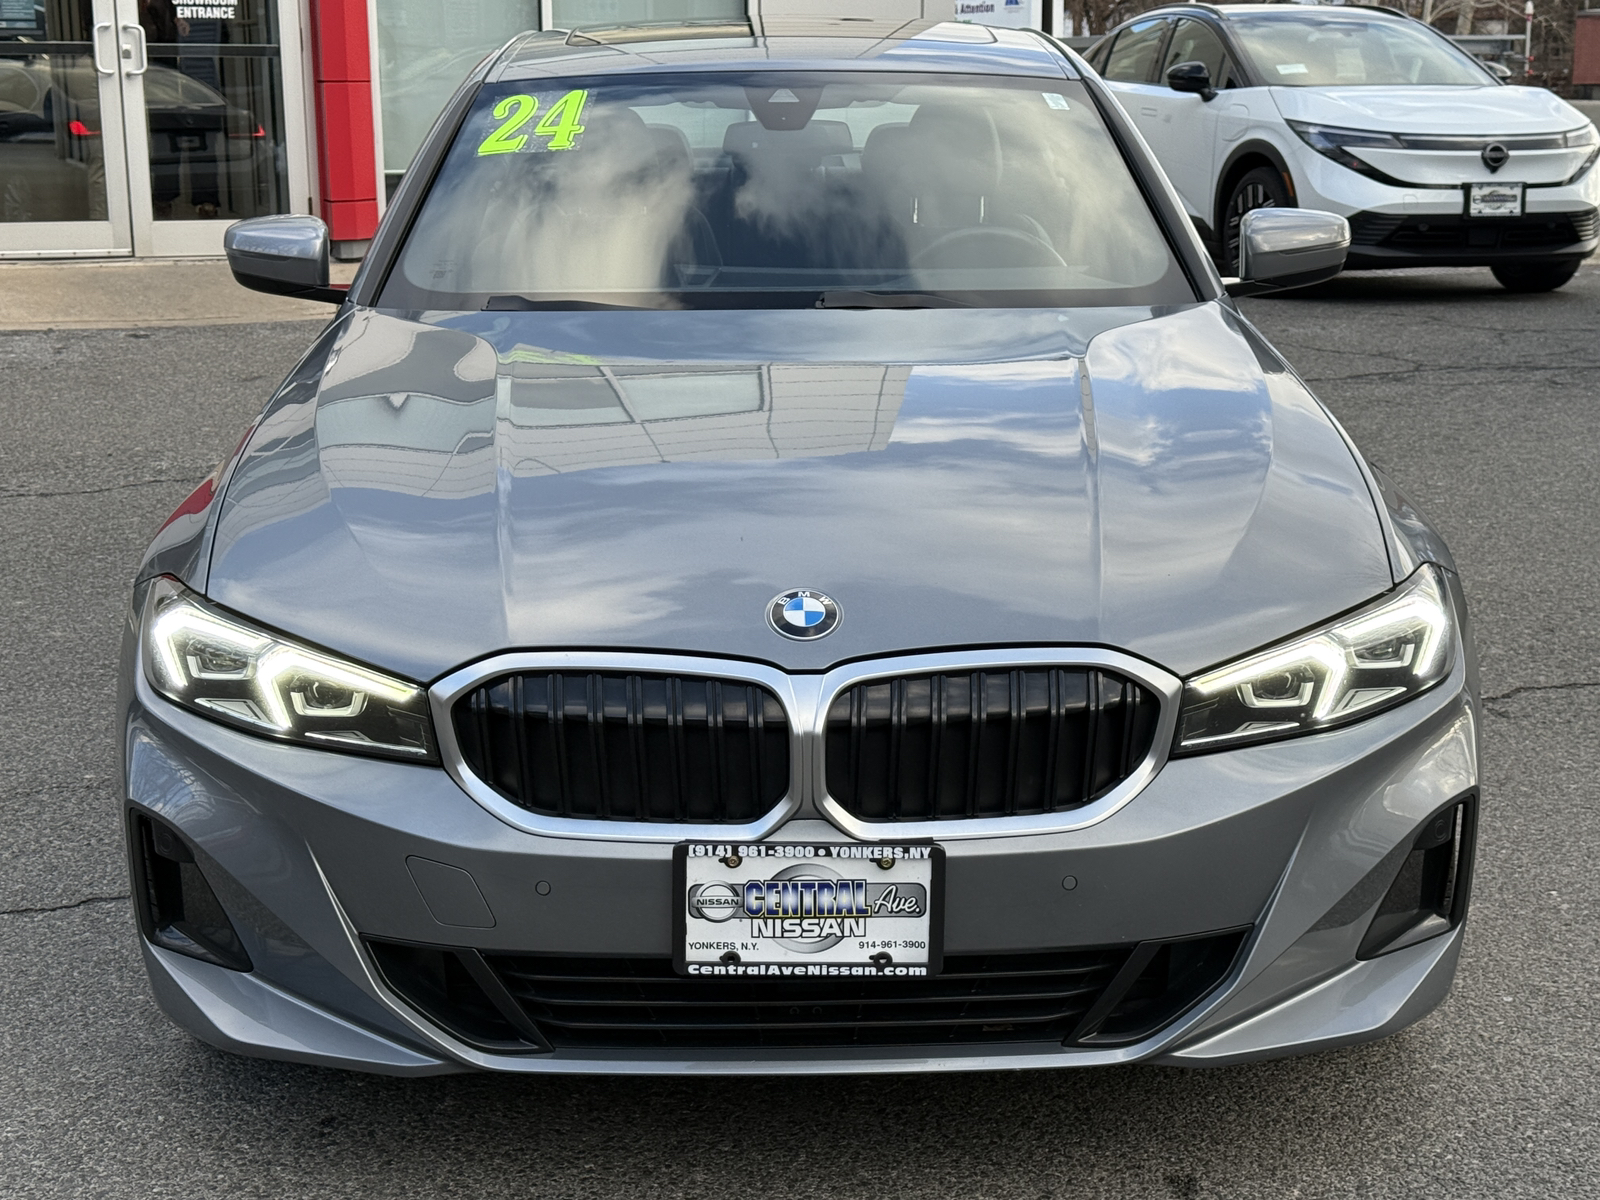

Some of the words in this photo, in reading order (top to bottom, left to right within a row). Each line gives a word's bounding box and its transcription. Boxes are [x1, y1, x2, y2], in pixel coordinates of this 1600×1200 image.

[176, 6, 236, 19] ENTRANCE
[960, 3, 995, 14] Attention
[477, 89, 588, 157] 24
[777, 591, 832, 605] BMW
[738, 845, 815, 858] 961-3900
[829, 846, 932, 860] YONKERS,NY
[696, 898, 739, 906] NISSAN
[743, 880, 872, 918] CENTRAL
[873, 884, 922, 914] Ave.
[751, 917, 866, 938] NISSAN
[688, 942, 739, 951] YONKERS,
[741, 942, 760, 951] N.Y.
[858, 940, 926, 949] 914-961-3900
[687, 964, 927, 976] CentralAveNissan.com
